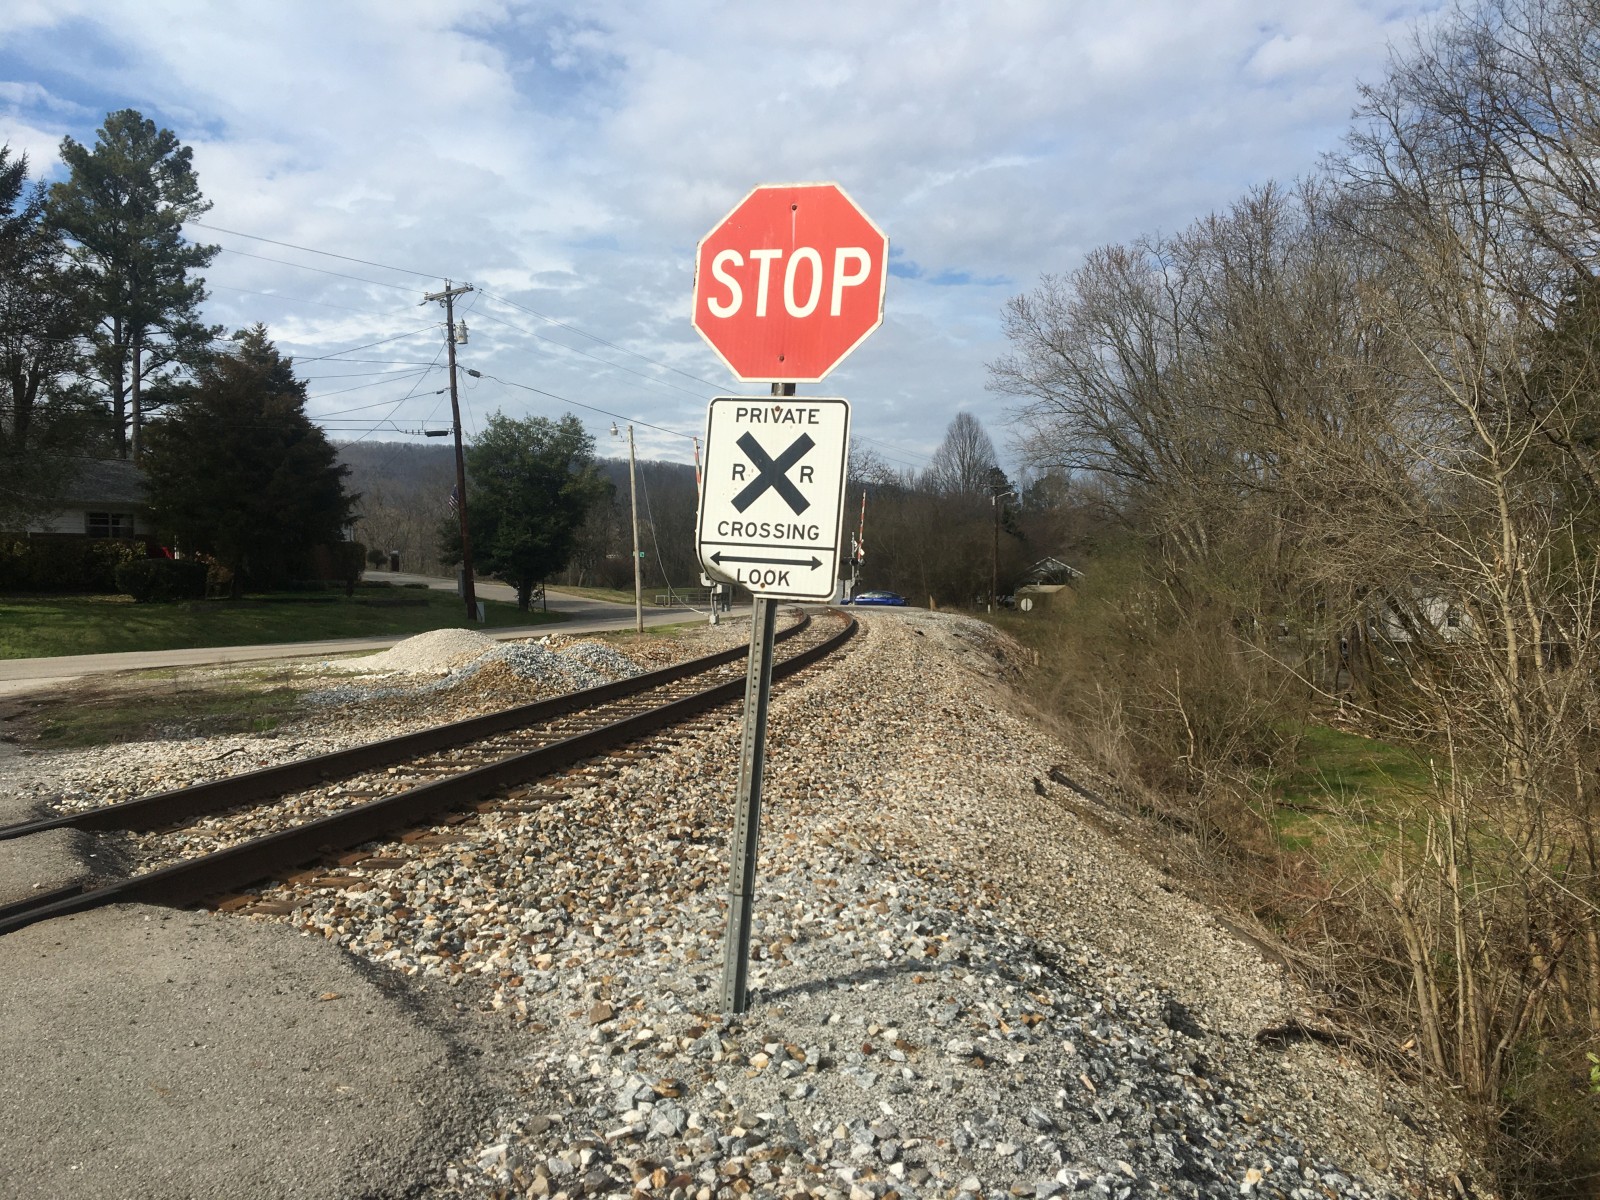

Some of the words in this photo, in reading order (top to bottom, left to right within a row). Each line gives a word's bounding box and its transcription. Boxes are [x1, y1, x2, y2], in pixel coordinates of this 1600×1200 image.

[707, 247, 871, 318] STOP
[736, 408, 820, 424] PRIVATE
[732, 464, 745, 480] R
[800, 466, 814, 483] R
[718, 521, 819, 540] CROSSING
[737, 569, 790, 586] LOOK
